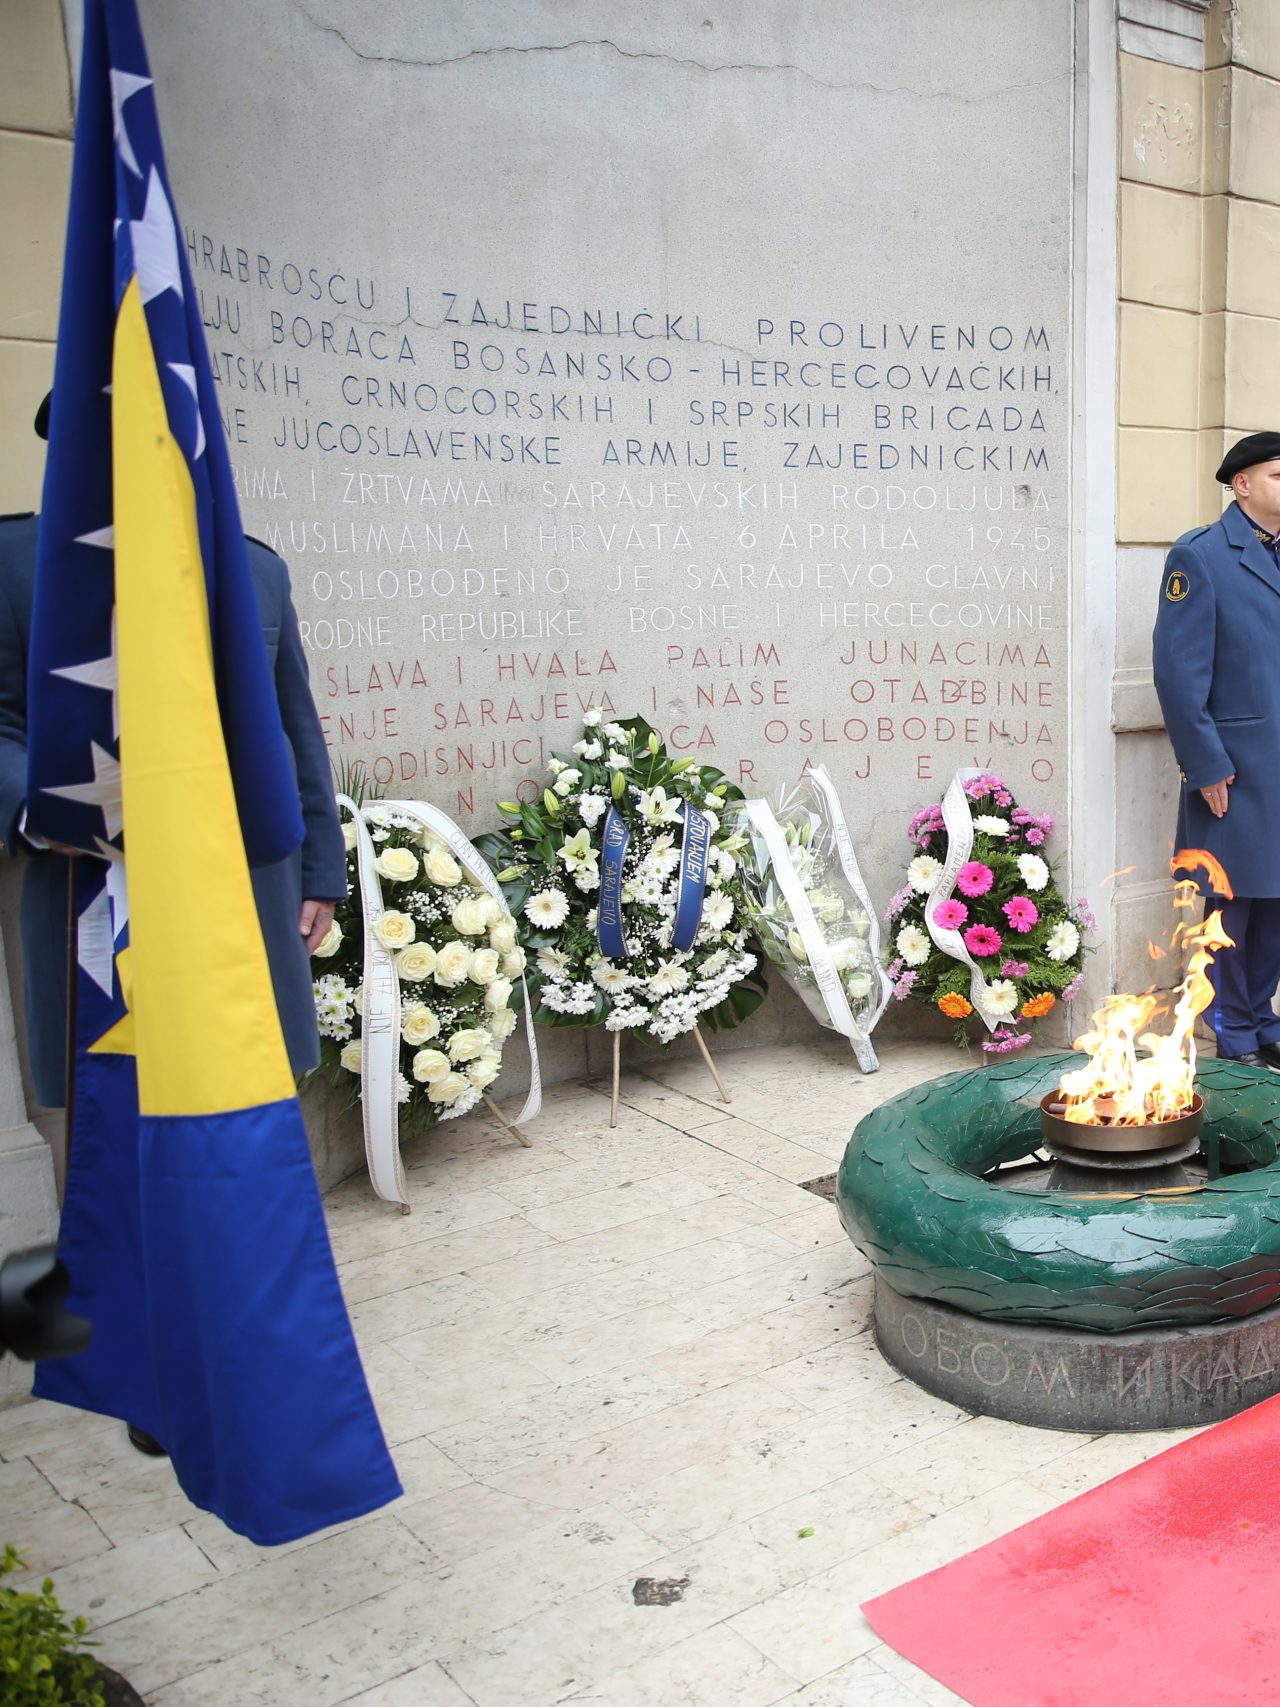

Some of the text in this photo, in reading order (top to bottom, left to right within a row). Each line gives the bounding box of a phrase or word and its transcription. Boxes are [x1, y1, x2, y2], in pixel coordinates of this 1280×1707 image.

[404, 286, 411, 317] I
[757, 318, 1050, 352] PROLIVENOM
[271, 310, 416, 365] BORACA
[453, 340, 672, 383] BOSANSKO
[340, 375, 613, 424] CRNOGORSKIH
[647, 398, 654, 425] I
[689, 400, 841, 429] SRPSKIH
[874, 404, 1046, 433] BRIGADA
[273, 414, 561, 465] JUGOSLAVENSKE
[602, 439, 748, 473] ARMIJE,
[310, 467, 317, 502] I
[542, 480, 799, 511] SARAJEVSKIH
[264, 520, 474, 553] MUSLIMANA
[503, 526, 509, 551] I
[539, 523, 693, 552] HRVATA
[739, 525, 757, 550] 6
[778, 523, 921, 551] APRILA
[967, 524, 1051, 552] 1945
[312, 563, 1054, 600] OSLOBOĐENO JE SARAJEVO GLAVNI
[422, 609, 583, 643] REPUBLIKE
[629, 603, 738, 633] BOSNE
[776, 603, 782, 627] I
[819, 602, 1053, 630] HERCEGOVINE
[326, 640, 1052, 697] SLAVA I HVALA PALIM JUNACIMA
[433, 690, 617, 731] SARAJEVA
[651, 686, 657, 711] I
[763, 717, 1054, 746] OSLOBOĐENJA
[601, 818, 625, 927] GRAD SARAJEVO
